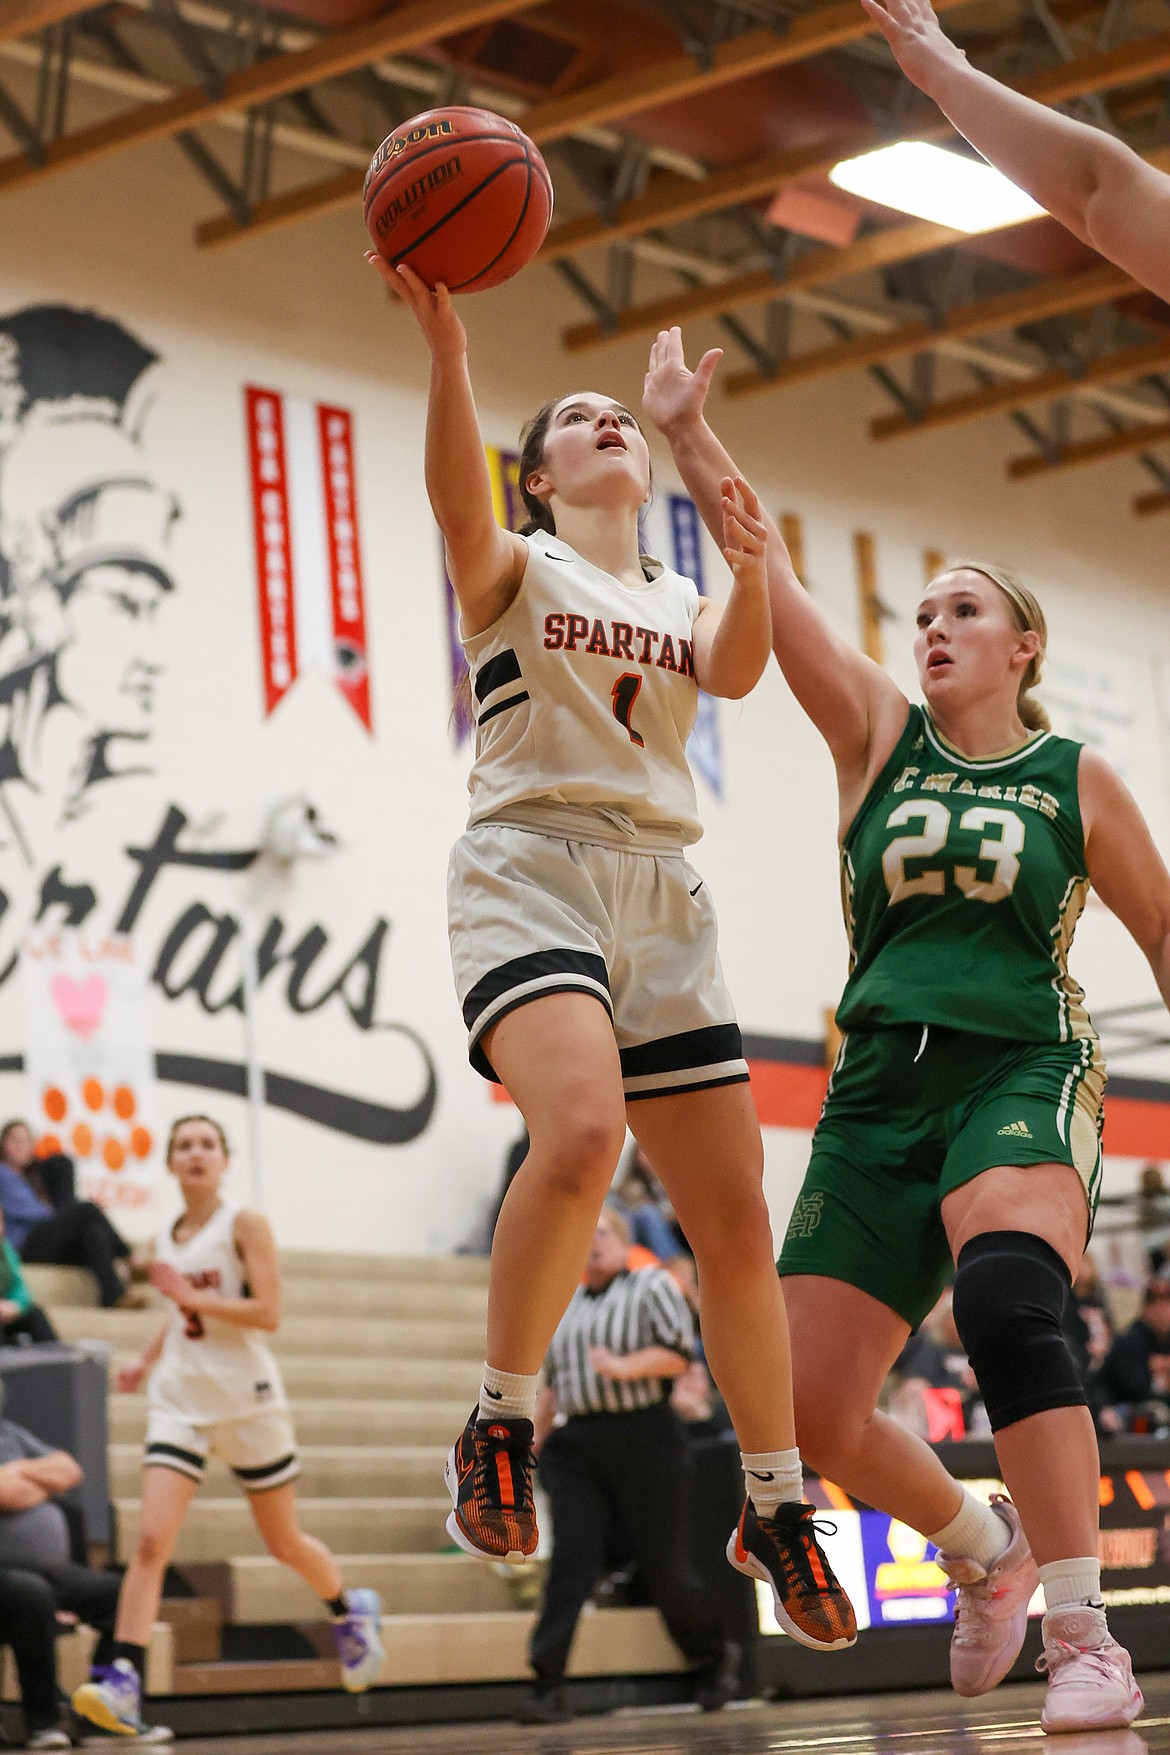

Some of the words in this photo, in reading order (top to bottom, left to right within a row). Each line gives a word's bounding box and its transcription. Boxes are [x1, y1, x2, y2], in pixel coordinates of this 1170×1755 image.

[375, 156, 463, 237] EVOLUTION
[610, 671, 645, 748] 1
[882, 797, 1026, 908] 23
[0, 801, 392, 1031] rtans
[997, 1129, 1034, 1139] adidas
